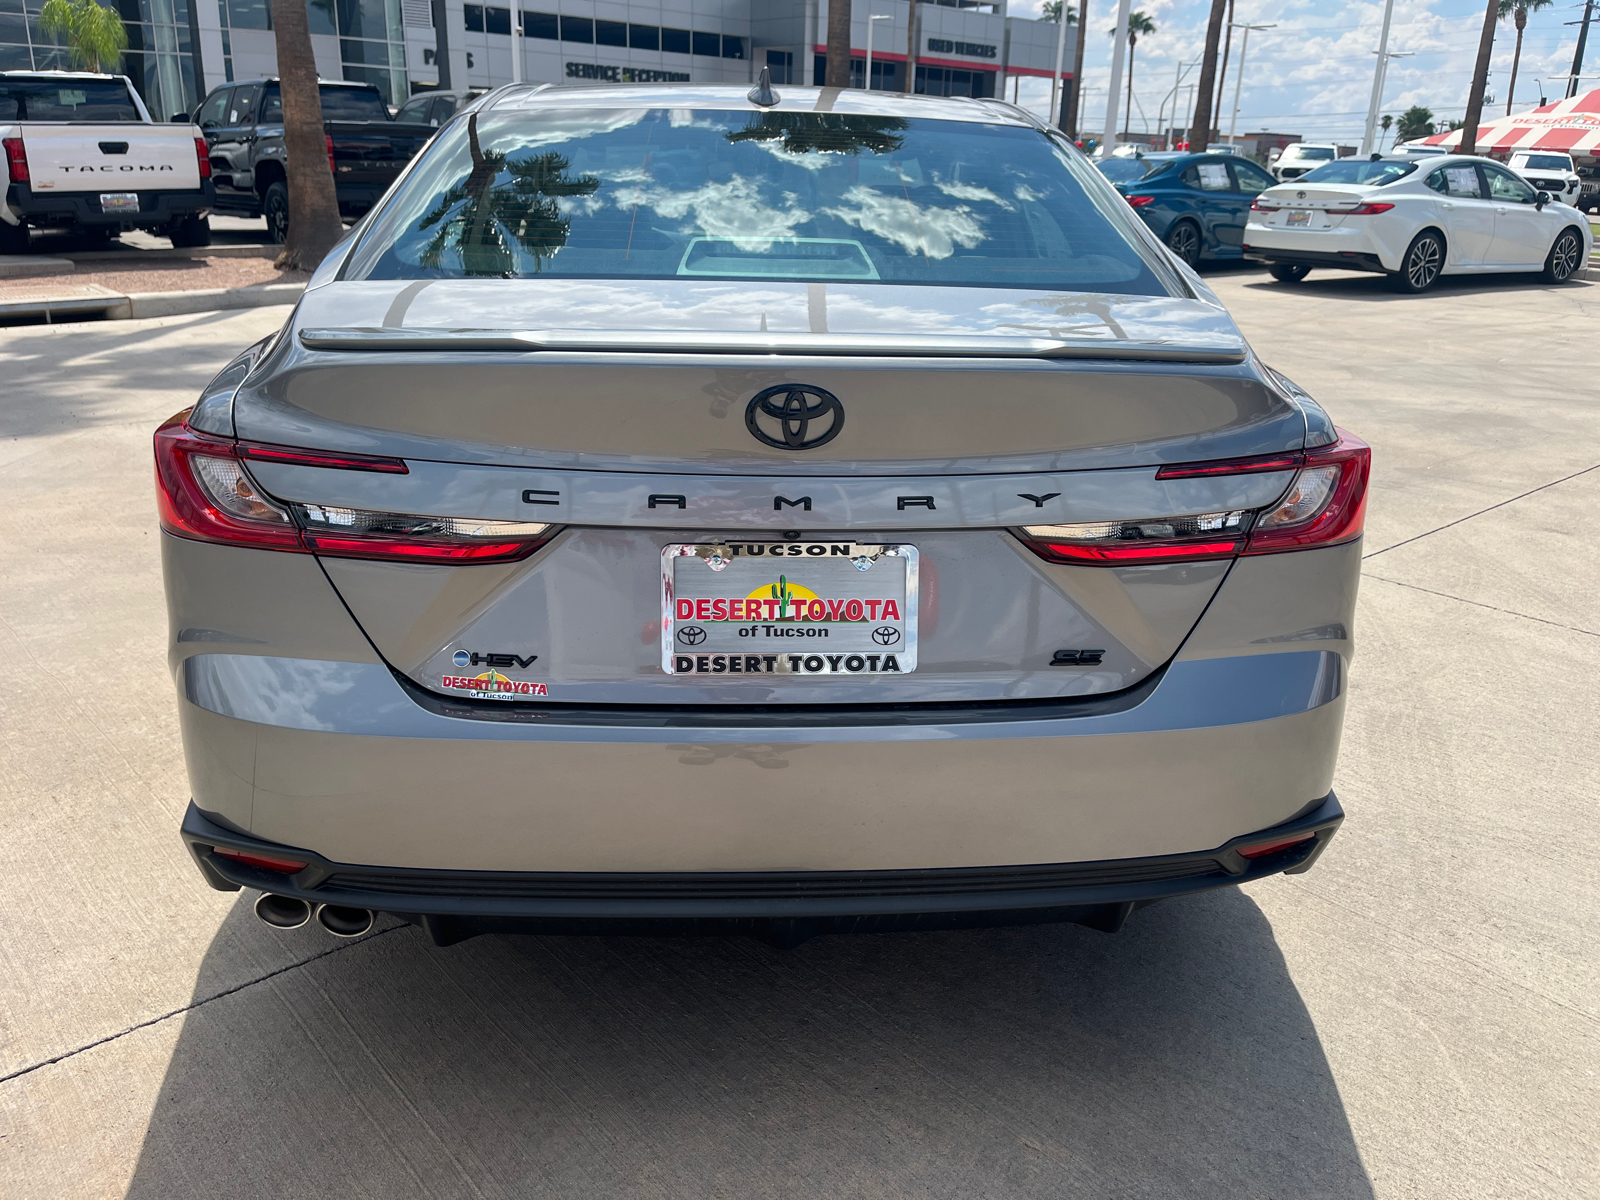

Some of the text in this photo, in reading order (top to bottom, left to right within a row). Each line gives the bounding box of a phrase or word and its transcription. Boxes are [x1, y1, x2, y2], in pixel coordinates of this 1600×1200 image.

[566, 62, 621, 83] SERVICE
[59, 165, 174, 173] TACOMA
[522, 489, 1062, 511] CAMRY
[729, 544, 850, 556] TUCSON
[676, 598, 901, 621] DESERT TOYOTA
[738, 625, 829, 637] of Tucson
[676, 655, 902, 674] DESERT TOYOTA
[442, 676, 548, 696] DESERT TOYOTA
[482, 692, 513, 700] Tucson
